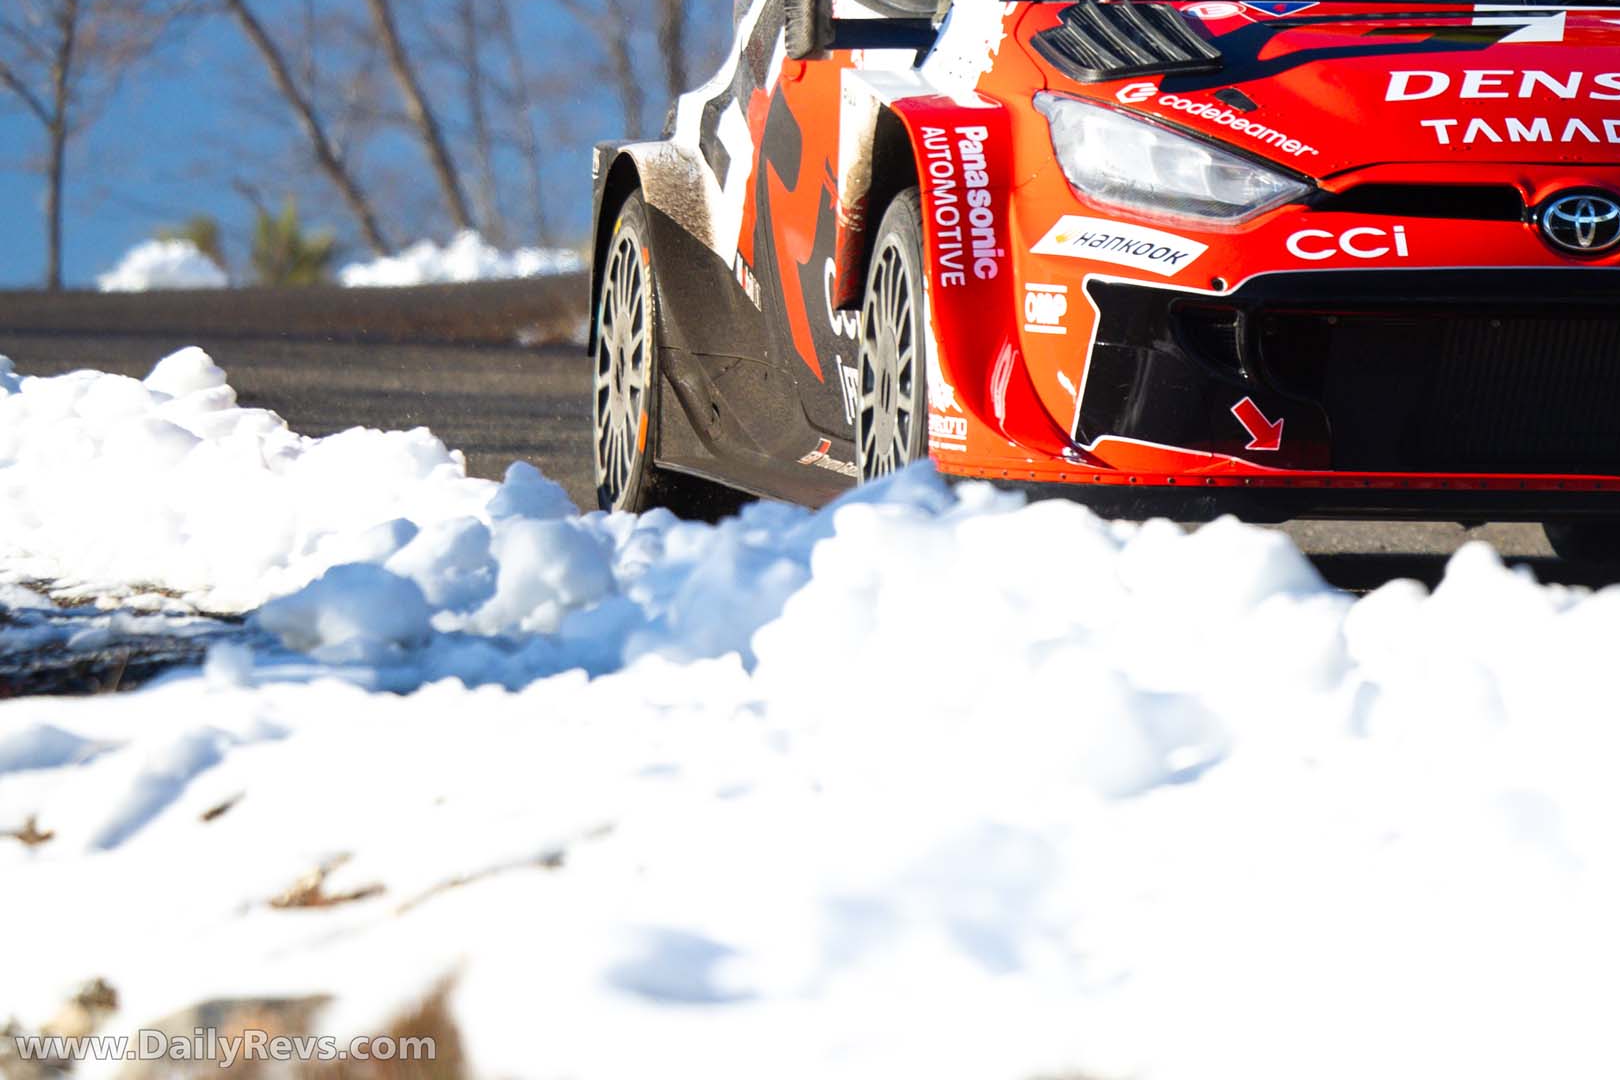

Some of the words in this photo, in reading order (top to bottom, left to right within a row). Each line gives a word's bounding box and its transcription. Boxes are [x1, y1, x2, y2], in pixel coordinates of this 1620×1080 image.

[954, 125, 1004, 281] Panasonic
[1158, 94, 1320, 157] codebeamer
[920, 126, 966, 288] AUTOMOTIVE
